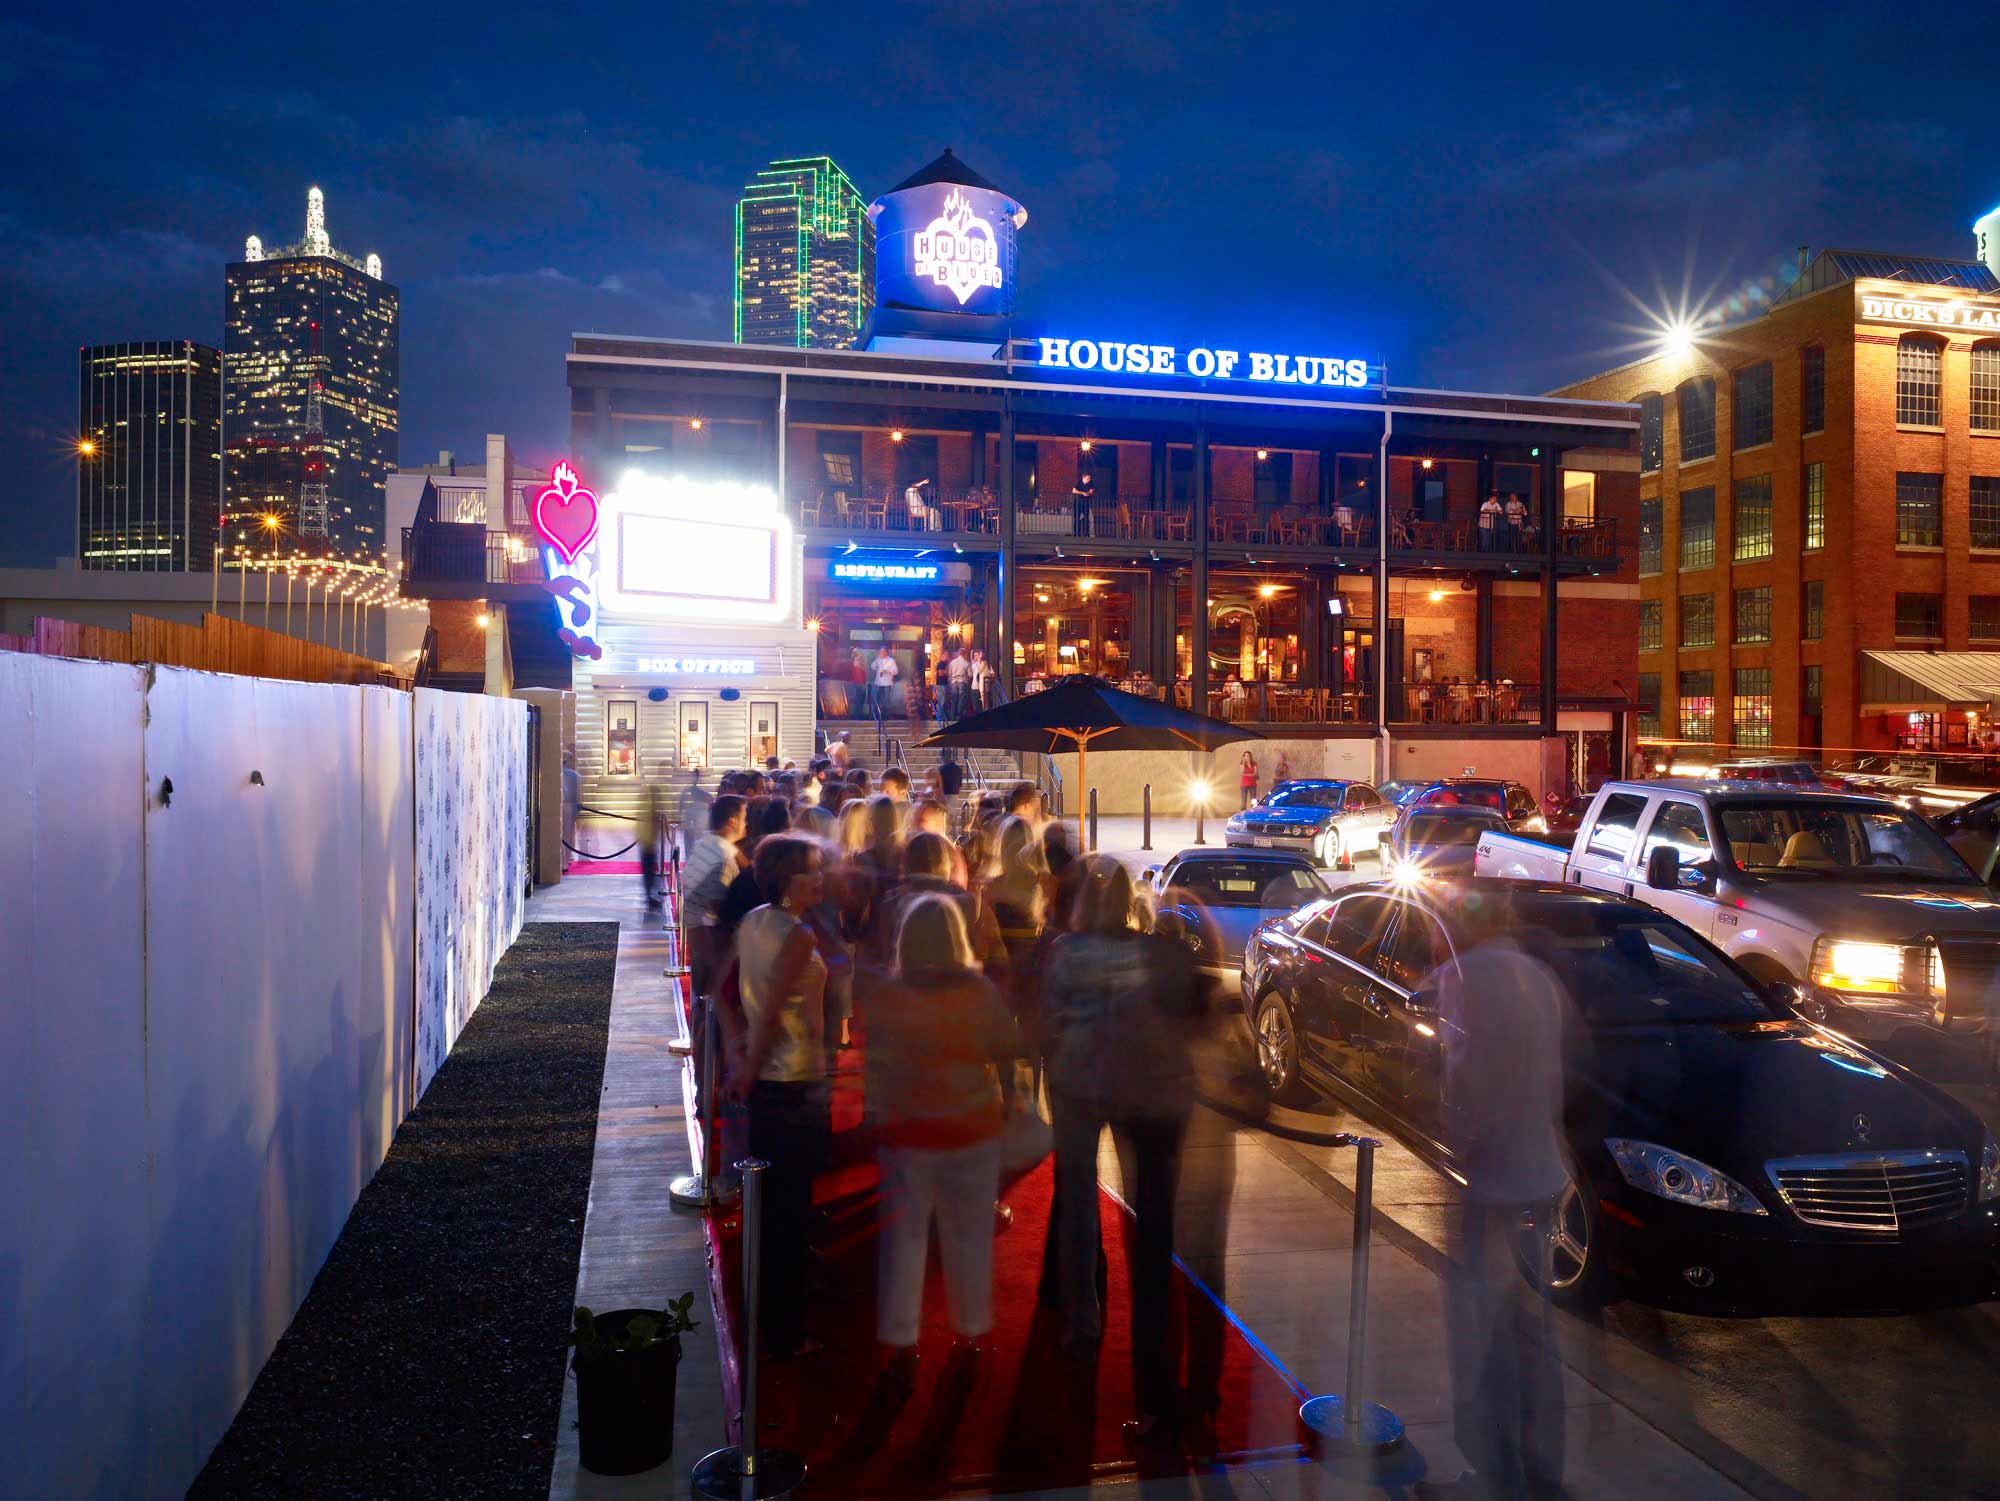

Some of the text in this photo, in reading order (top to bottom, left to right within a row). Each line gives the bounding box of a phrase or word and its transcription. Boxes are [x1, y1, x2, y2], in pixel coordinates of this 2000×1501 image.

[1862, 299, 2000, 329] DICK'S LA
[1038, 337, 1368, 388] HOUSE OF BLUES
[834, 564, 938, 579] RESTAURANT
[637, 657, 755, 674] BOX OFFICE
